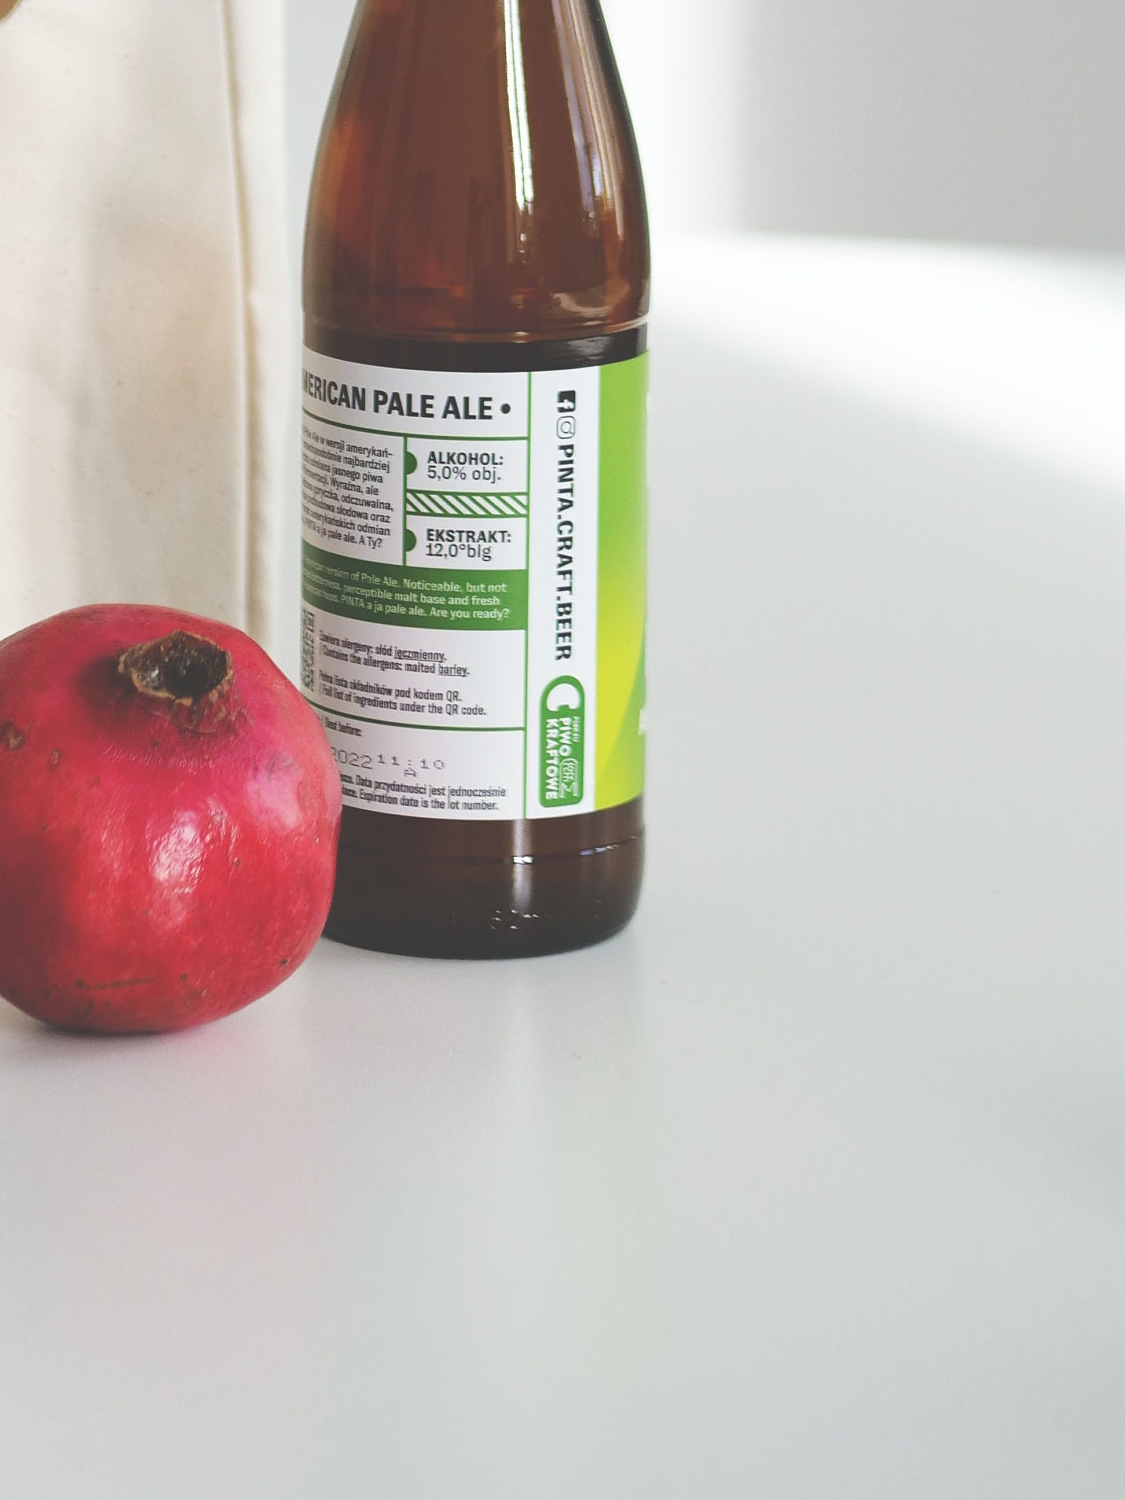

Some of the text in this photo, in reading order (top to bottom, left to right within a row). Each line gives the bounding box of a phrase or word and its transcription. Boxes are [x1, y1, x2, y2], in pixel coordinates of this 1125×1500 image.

[373, 389, 435, 419] PALE
[442, 395, 493, 420] ALE
[325, 438, 345, 453] wersji
[346, 443, 393, 458] amerykań-
[427, 451, 504, 466] ALKOHOL:
[332, 464, 361, 482] jasnego
[362, 471, 384, 484] piwa
[343, 456, 391, 474] najbardziej
[427, 465, 501, 484] 5,0% obj.
[365, 485, 379, 496] ale
[341, 494, 394, 512] odczuwalna,
[370, 513, 391, 524] oraz
[328, 528, 342, 541] pale
[343, 533, 357, 545] ale.
[359, 535, 365, 546] A
[367, 536, 383, 550] Ty?
[357, 522, 391, 537] odmian
[426, 528, 511, 543] EKSTRAKT:
[425, 543, 492, 562] 12,0°blg
[555, 444, 574, 661] PINTA.CRAFT.BEER
[350, 571, 360, 581] of
[361, 573, 381, 585] Pale
[383, 576, 401, 588] Ale.
[465, 581, 486, 593] but
[487, 582, 507, 593] not
[343, 584, 393, 601] perceptible
[394, 591, 418, 603] malt
[420, 593, 445, 605] base
[448, 595, 469, 606] and
[471, 595, 501, 606] fresh
[341, 594, 511, 621] PINTA a ja pale ale. Are you ready?
[349, 653, 361, 665] the
[362, 656, 403, 672] allergens:
[404, 661, 436, 674] malted
[438, 663, 471, 678] barley.
[344, 691, 352, 702] of
[353, 693, 398, 709] ingredients
[399, 701, 425, 713] under
[427, 702, 443, 714] the
[445, 703, 459, 716] QR
[460, 704, 488, 715] code.
[394, 687, 411, 699] pod
[413, 688, 443, 701] kodem
[445, 690, 463, 702] QR.
[558, 717, 572, 756] PIWO
[545, 718, 560, 800] KRAFTOWE
[355, 774, 373, 789] Data
[374, 780, 427, 795] przydatności
[429, 784, 446, 798] jest
[447, 785, 507, 799] jednocześnie
[359, 788, 398, 804] Expiration
[400, 795, 419, 808] date
[420, 797, 429, 808] is
[430, 798, 446, 810] the
[447, 798, 460, 810] lot
[461, 800, 499, 811] number.
